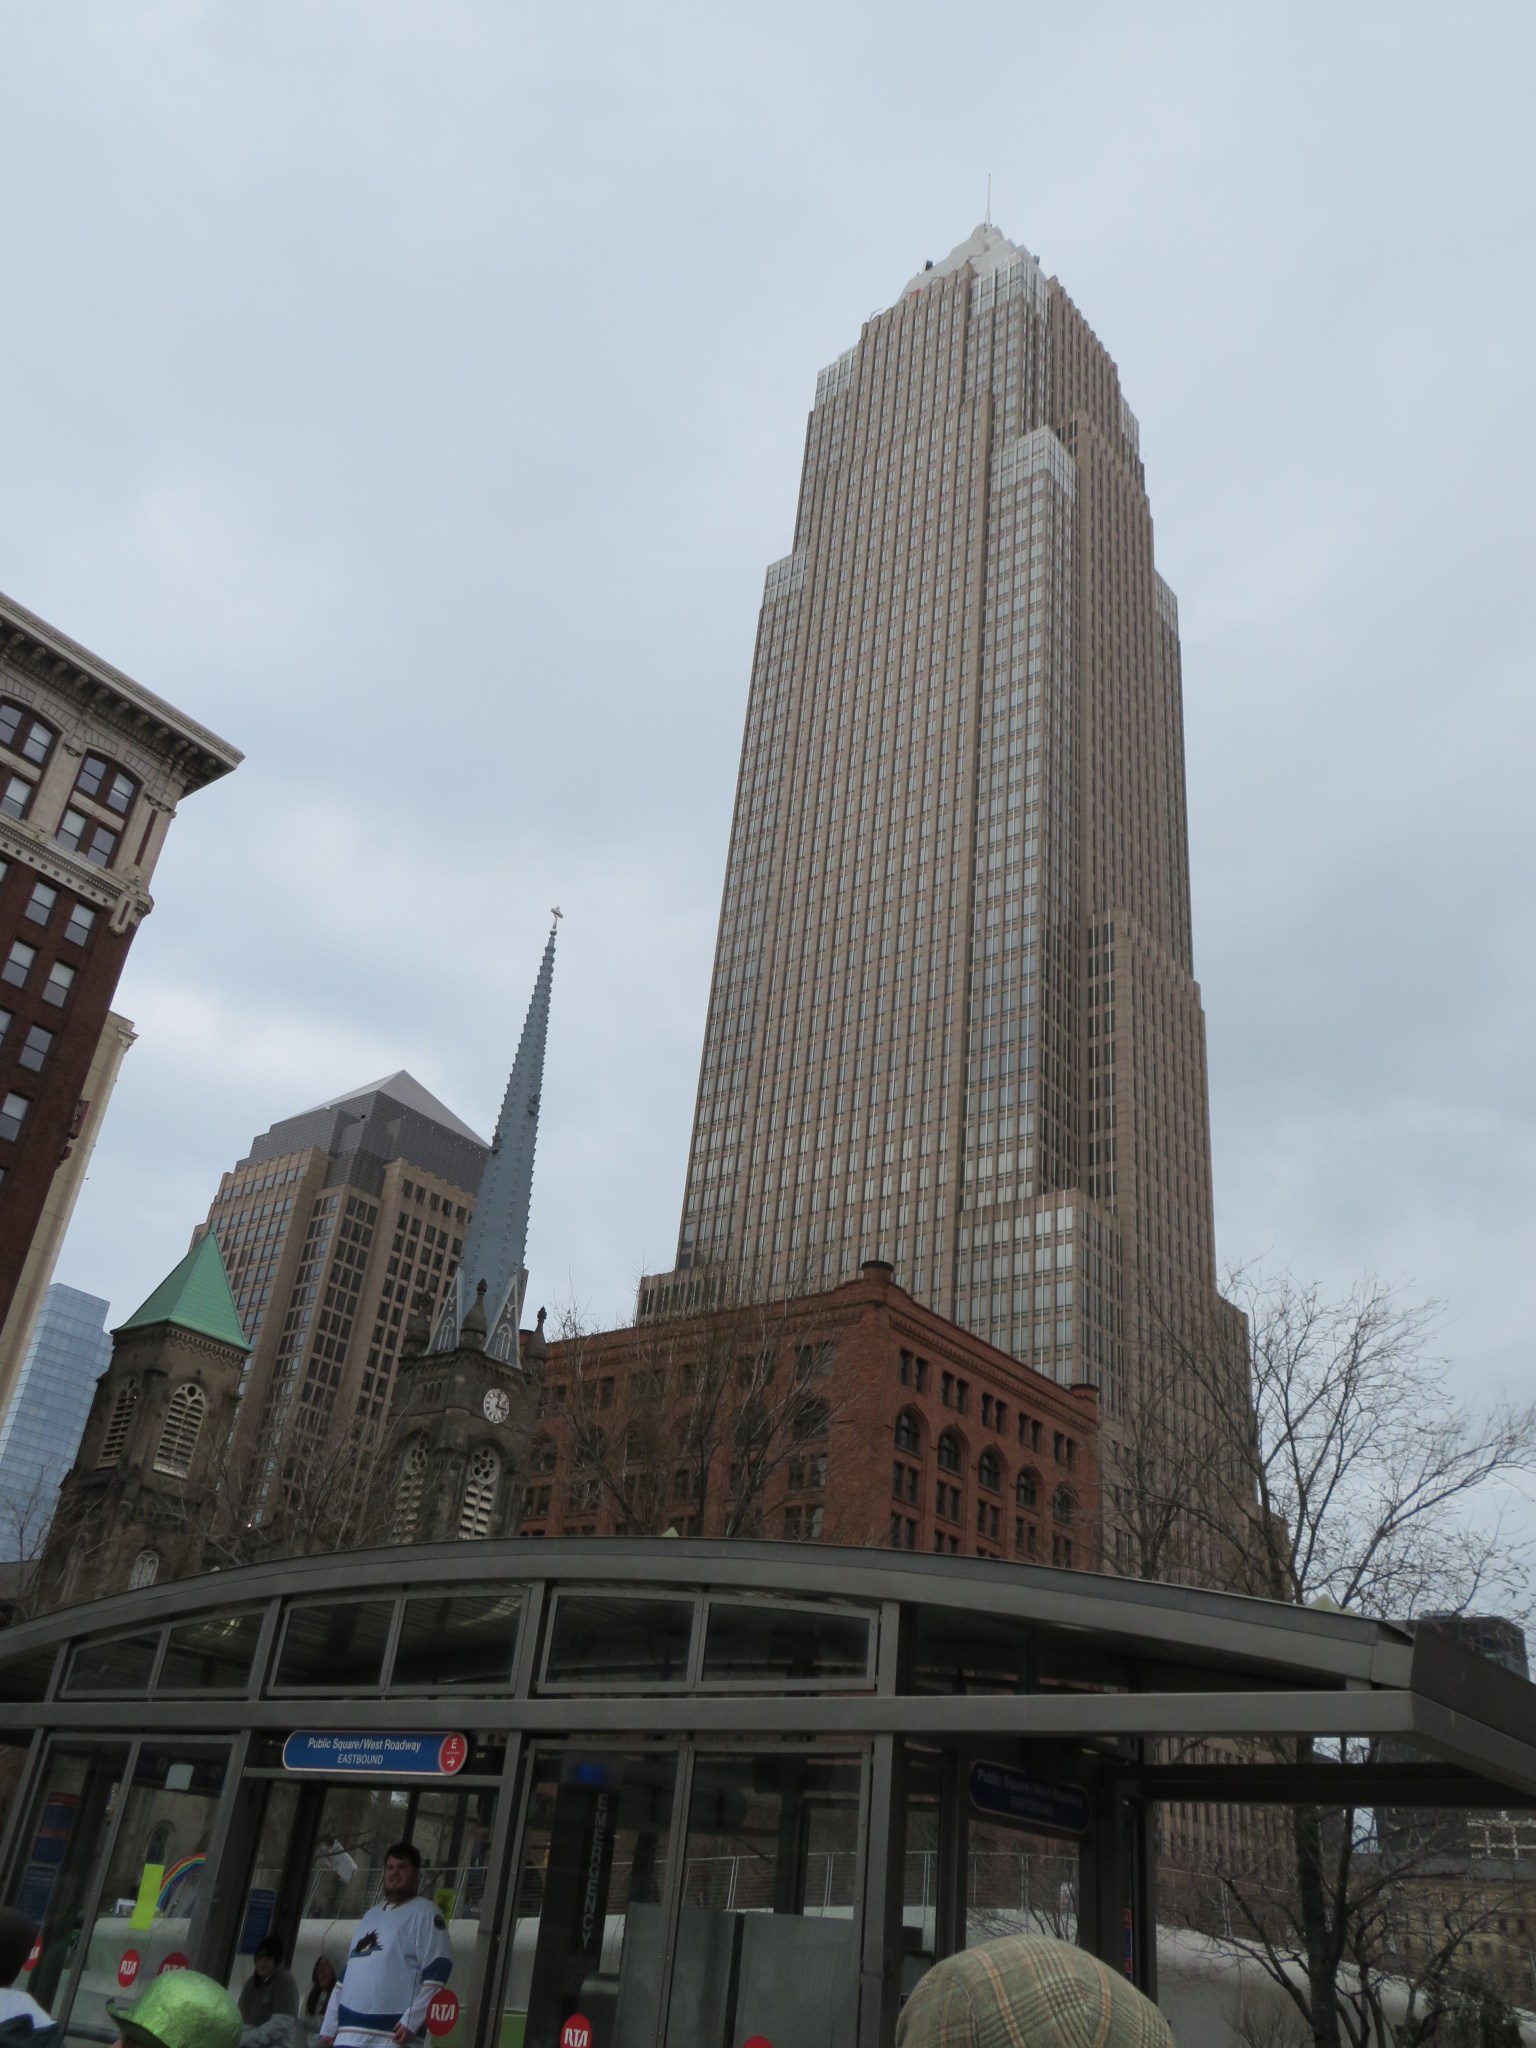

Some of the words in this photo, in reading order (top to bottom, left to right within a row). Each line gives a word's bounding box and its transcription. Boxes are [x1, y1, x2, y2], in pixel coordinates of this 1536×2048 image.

[308, 1738, 332, 1749] Public
[332, 1738, 385, 1751] Square/West
[384, 1738, 422, 1754] Roadway
[450, 1738, 458, 1750] E
[337, 1753, 384, 1765] EASTBOUND
[977, 1768, 1002, 1787] Public
[581, 1793, 609, 1949] EMERGENCY
[120, 1960, 137, 1975] RTA
[430, 2003, 456, 2021] RTA
[563, 2028, 589, 2048] RTA
